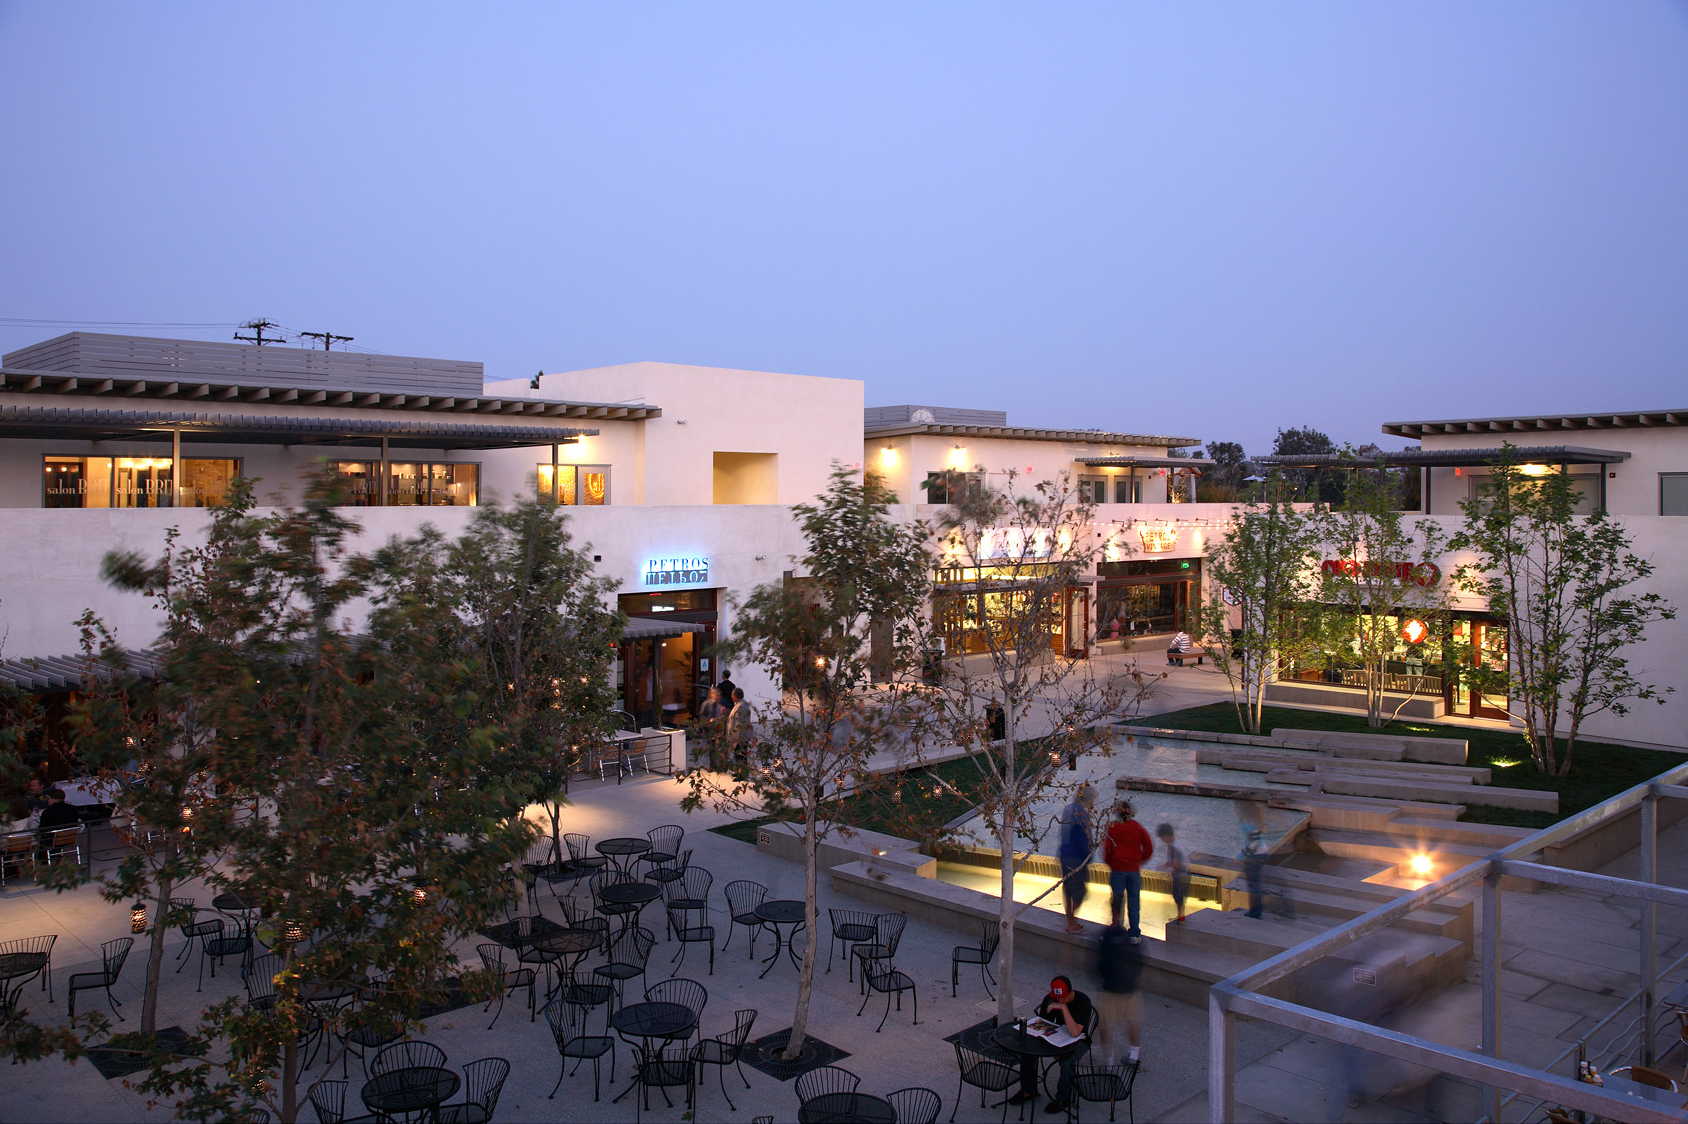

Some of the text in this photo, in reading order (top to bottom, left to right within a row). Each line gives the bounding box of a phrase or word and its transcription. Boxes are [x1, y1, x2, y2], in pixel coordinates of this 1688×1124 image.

[47, 479, 110, 495] salon BRIT
[117, 479, 144, 495] salon
[649, 557, 709, 571] PETROS
